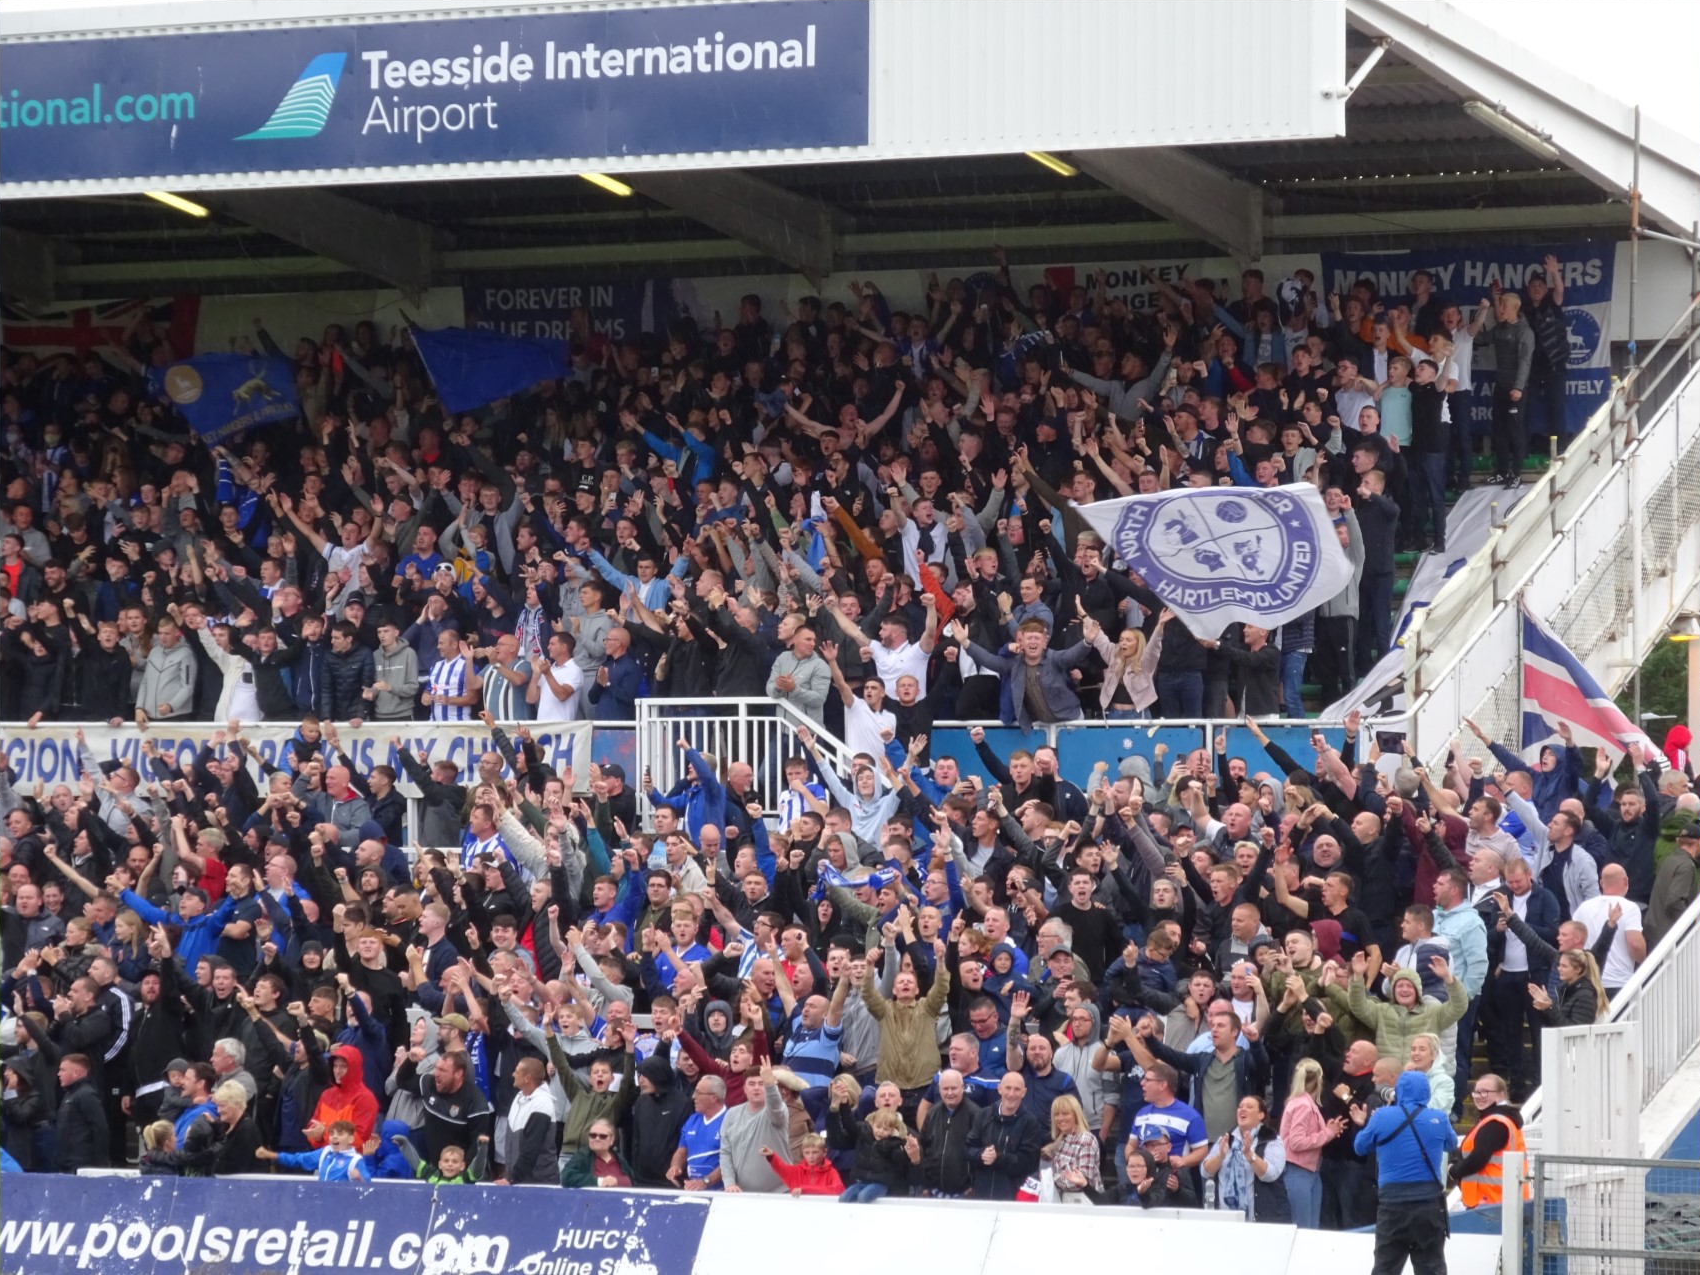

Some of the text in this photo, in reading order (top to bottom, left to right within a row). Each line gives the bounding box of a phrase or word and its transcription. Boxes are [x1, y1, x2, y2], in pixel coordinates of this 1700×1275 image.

[361, 25, 817, 90] Teesside International
[361, 94, 499, 144] Airport
[484, 285, 614, 310] FOREVER IN
[1156, 579, 1281, 606] HARTLEPOOL
[1275, 541, 1311, 601] UNITED
[350, 737, 375, 777] IS
[386, 736, 437, 784] MY
[557, 1228, 639, 1250] HUFC's
